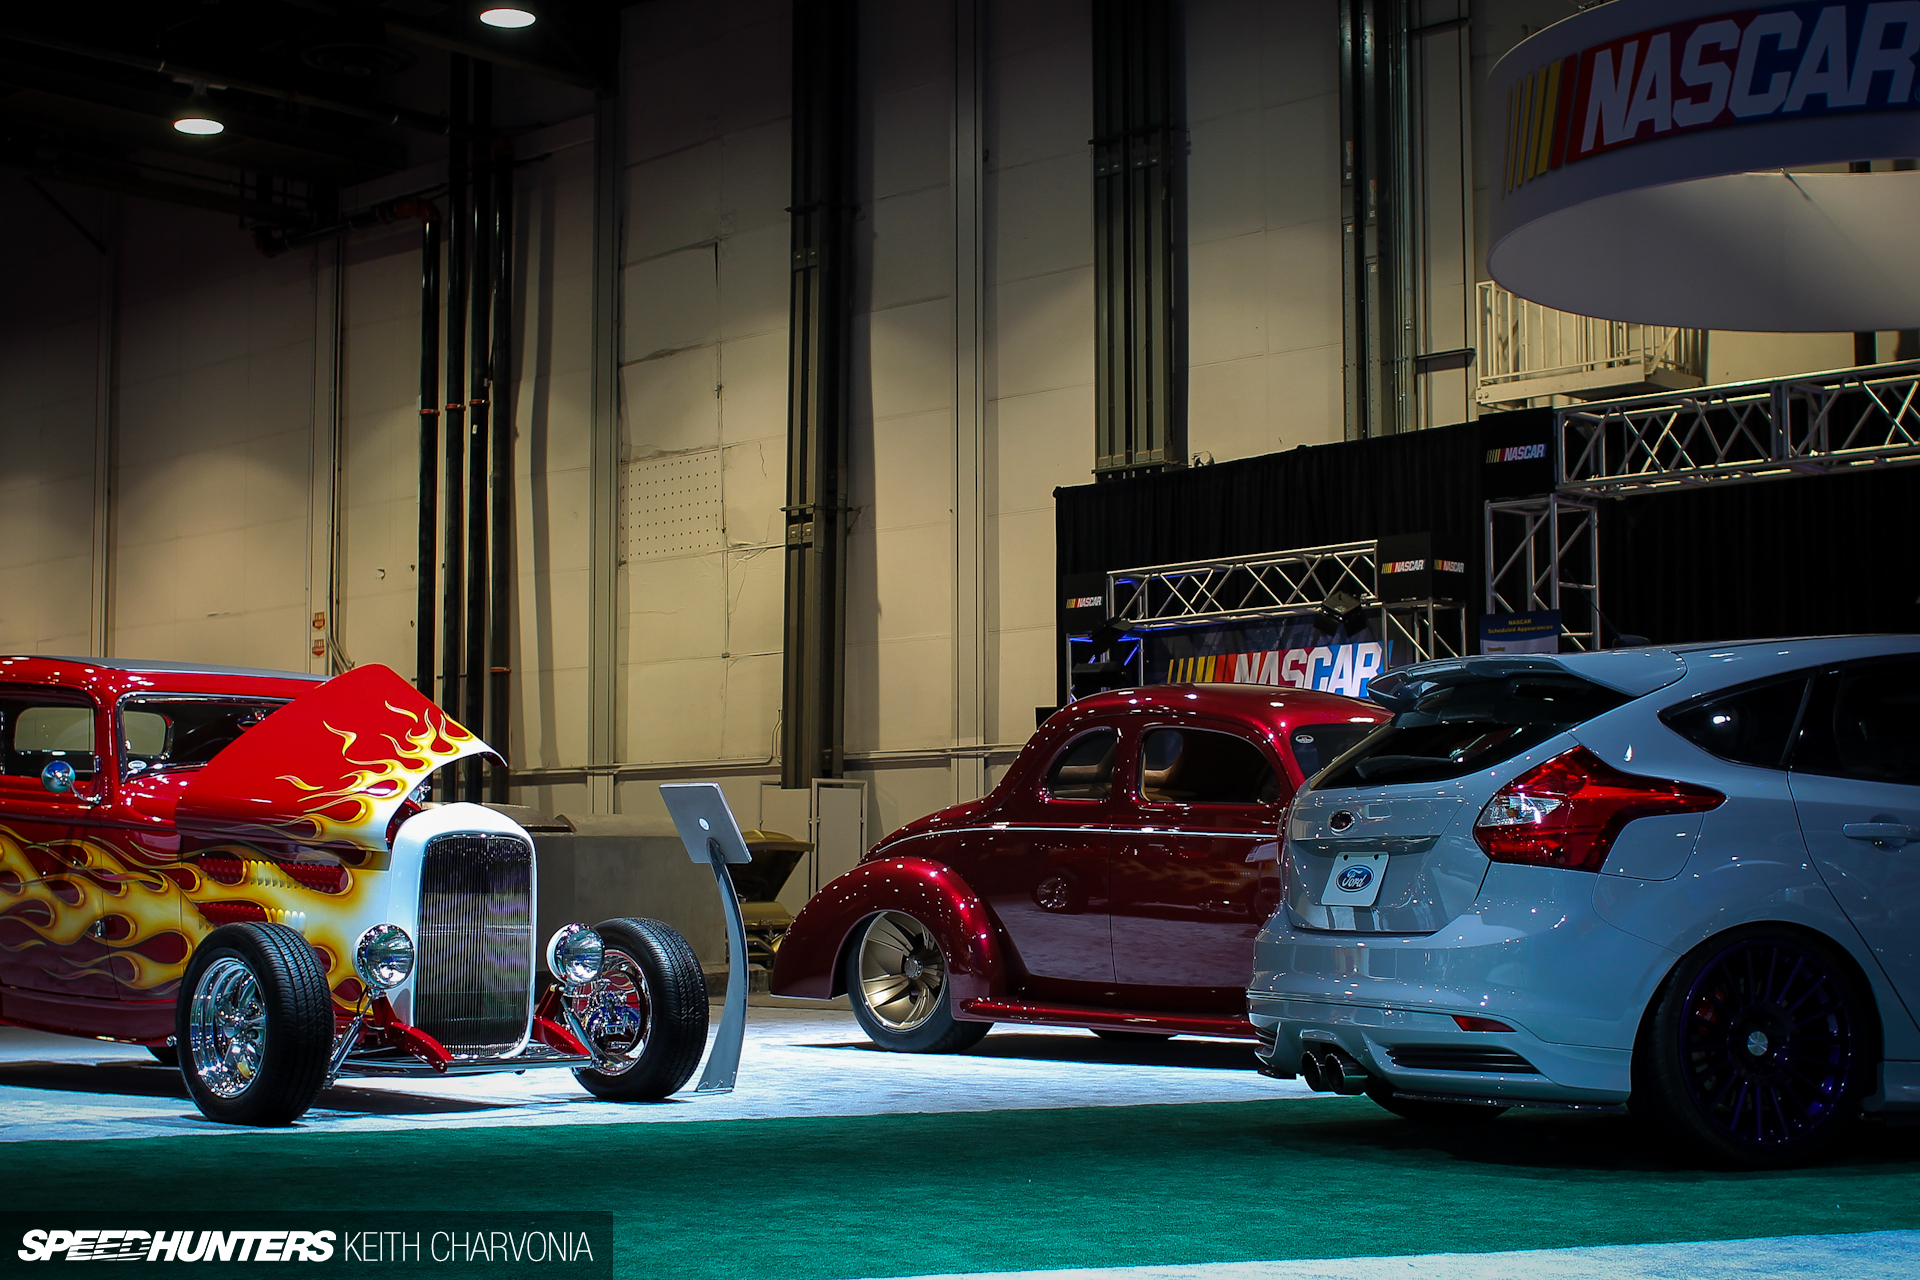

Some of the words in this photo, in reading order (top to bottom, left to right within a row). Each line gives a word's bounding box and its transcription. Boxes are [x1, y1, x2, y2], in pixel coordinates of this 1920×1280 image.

[1580, 1, 1920, 153] NASCAR
[1504, 443, 1545, 461] NASCAR
[1394, 559, 1424, 573] NASCAR
[1442, 560, 1465, 573] NASCAR
[1077, 596, 1102, 608] NASCAR
[1341, 869, 1366, 888] Ford
